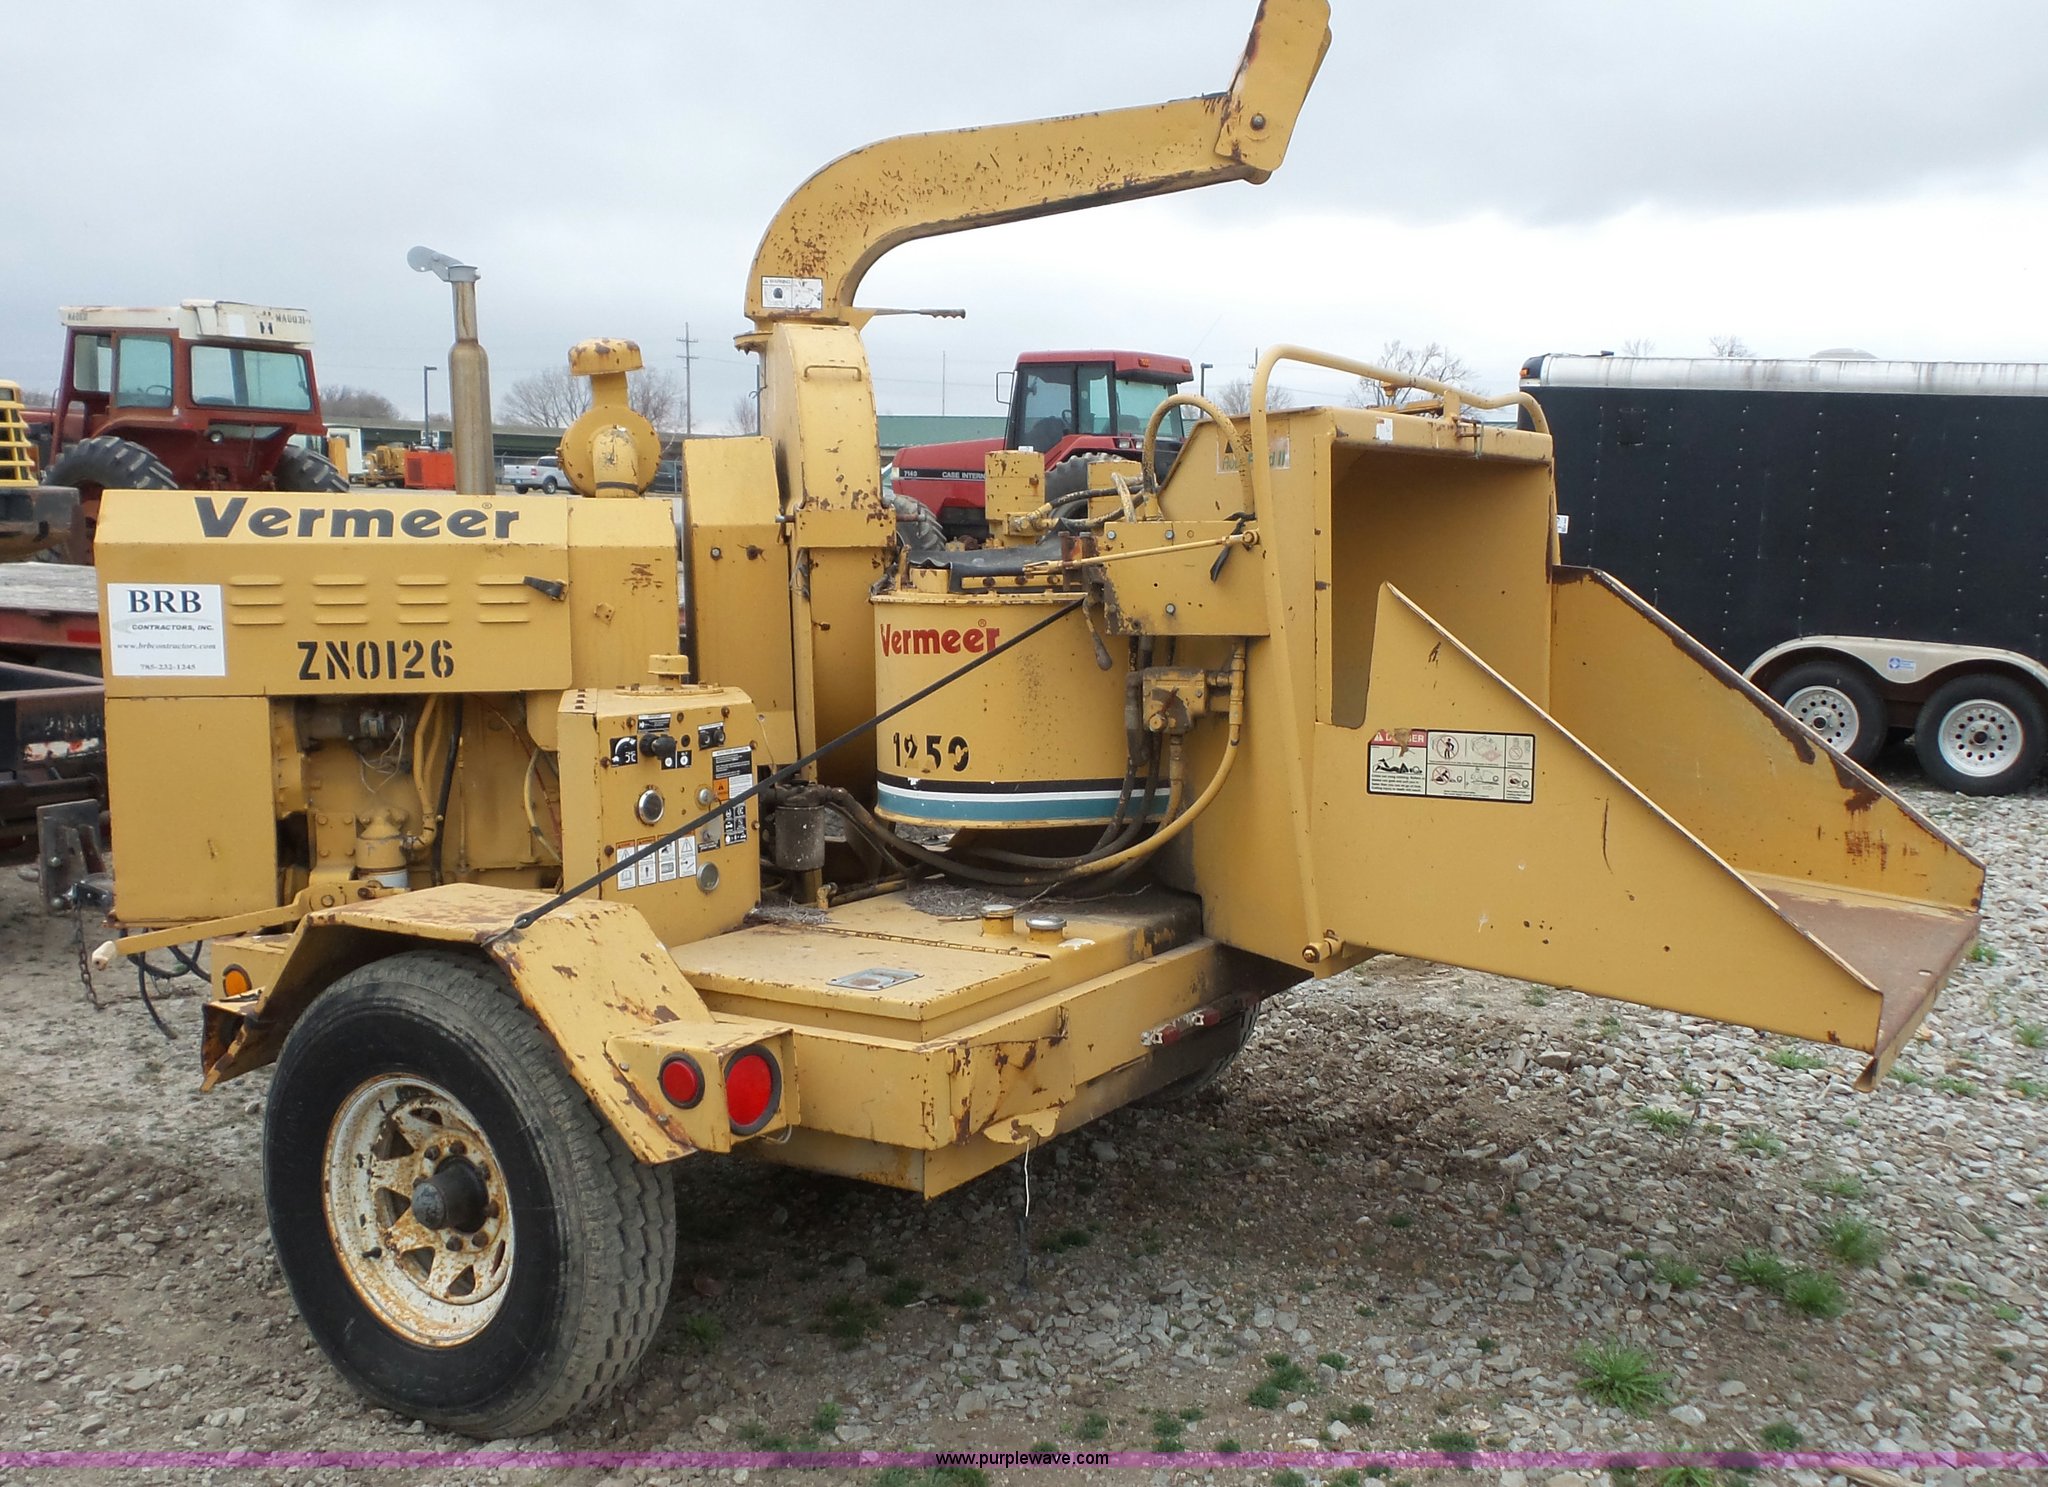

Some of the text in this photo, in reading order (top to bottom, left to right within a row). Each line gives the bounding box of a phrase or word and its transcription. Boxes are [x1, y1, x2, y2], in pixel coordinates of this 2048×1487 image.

[942, 471, 960, 479] CASE
[194, 497, 520, 539] Vermeer
[127, 590, 202, 613] BRB
[117, 642, 216, 650] www.brbcontractors.com
[880, 623, 1000, 657] Vermeer
[297, 639, 454, 680] ZN0126
